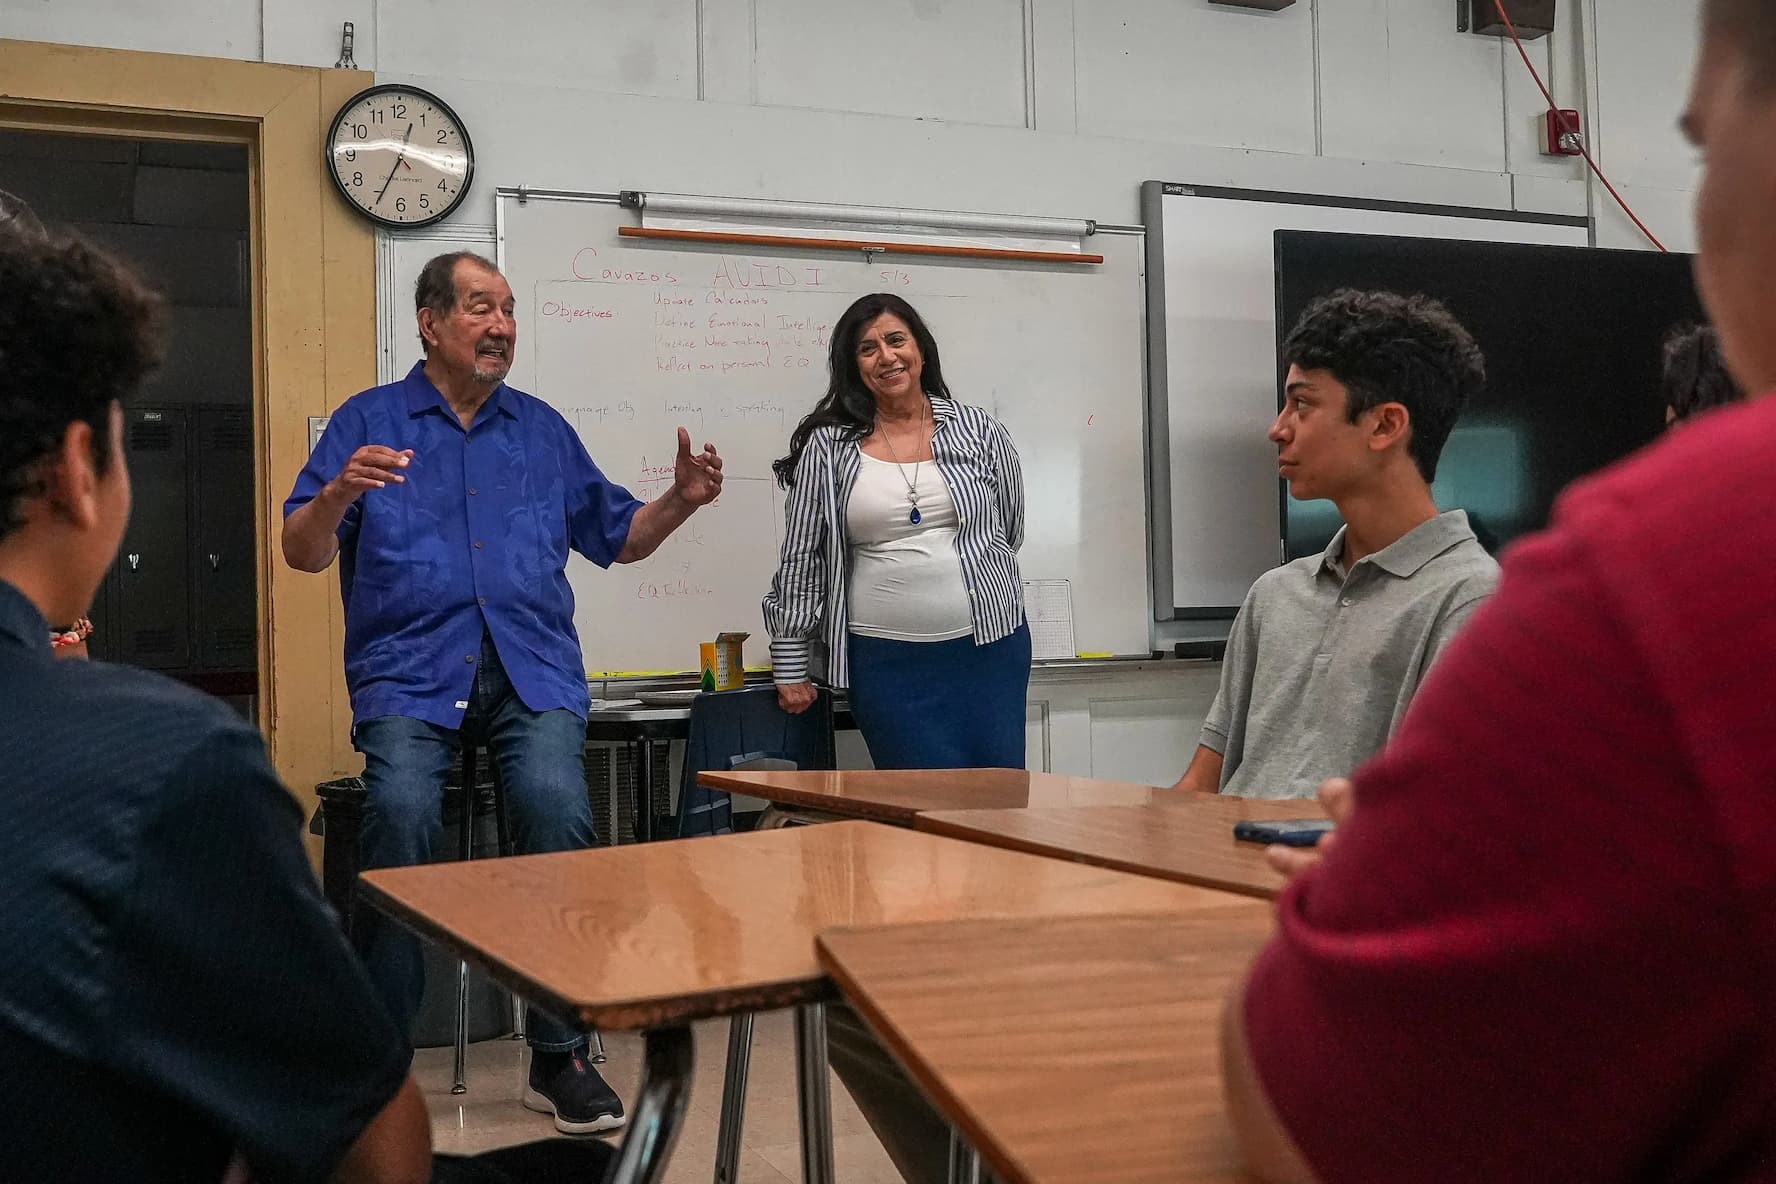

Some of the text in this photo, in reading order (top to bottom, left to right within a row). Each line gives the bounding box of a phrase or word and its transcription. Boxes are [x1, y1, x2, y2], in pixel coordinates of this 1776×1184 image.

[370, 109, 384, 125] 11
[390, 104, 407, 120] 12
[419, 113, 426, 127] 1
[351, 124, 368, 139] 10
[436, 129, 447, 144] 2
[345, 147, 356, 162] 9
[352, 171, 363, 187] 8
[437, 178, 448, 192] 4
[395, 197, 406, 212] 6
[419, 193, 429, 208] 5
[572, 247, 678, 283] Cavazos
[542, 301, 613, 322] Objectives
